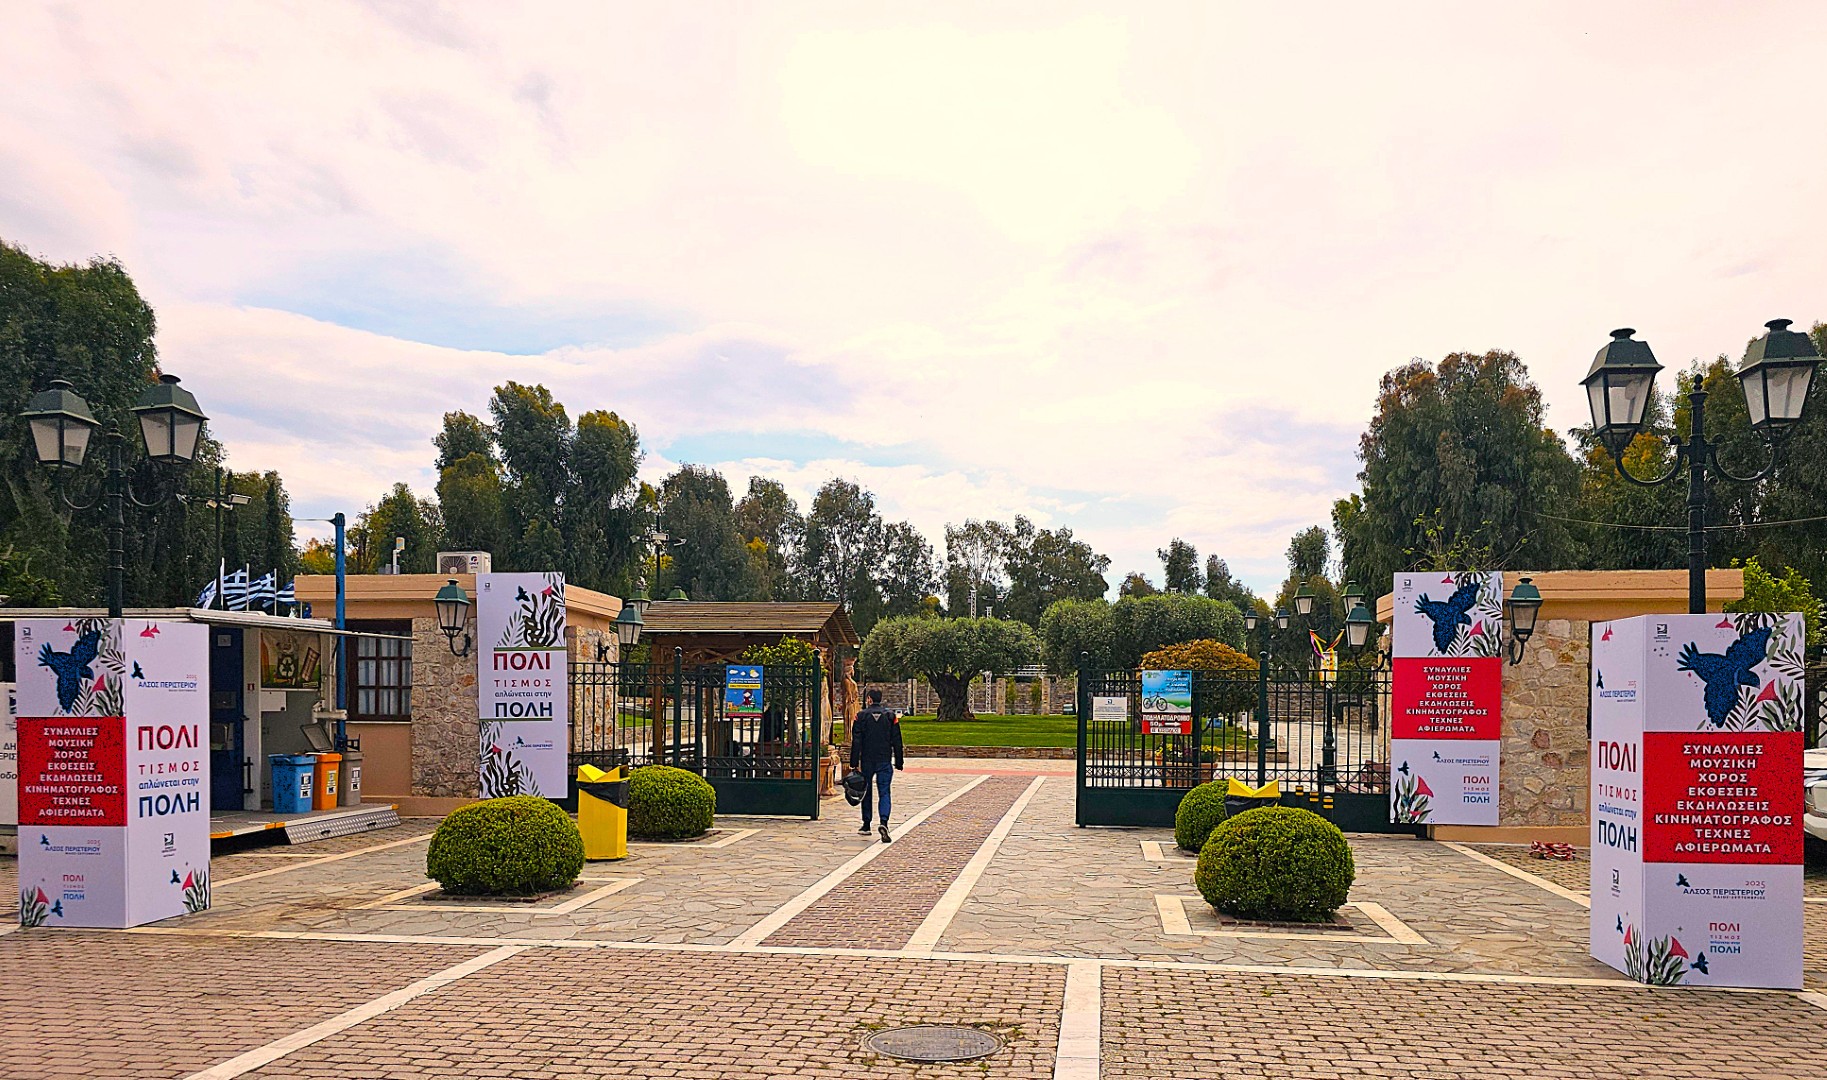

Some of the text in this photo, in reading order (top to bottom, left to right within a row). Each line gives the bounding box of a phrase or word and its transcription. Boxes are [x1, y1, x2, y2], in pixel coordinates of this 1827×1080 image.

[494, 652, 550, 670] ΠΟΛΙ
[494, 679, 551, 688] ΤΙΣΜΟΣ
[495, 702, 552, 718] ΠΟΛΗ
[44, 727, 98, 736] ΣΥΝΑΥΛΙΕΣ
[138, 724, 198, 751] ΠΟΛΙ
[48, 739, 94, 747] ΜΟΥΣΙΚΗ
[1683, 744, 1764, 754] ΣΥΝΑΥΛΙΕΣ
[54, 751, 88, 759] ΧΟΡΟΣ
[1598, 741, 1636, 772] ΠΟΛΙ
[48, 762, 96, 770] ΕΚΘΕΣΕΙΣ
[138, 760, 200, 776] ΤΙΣΜΟΣ
[1690, 759, 1756, 768] ΜΟΥΣΙΚΗ
[40, 774, 103, 782] ΕΚΔΗΛΩΣΕΙΣ
[1464, 776, 1490, 784] ΠΟΛΙ
[1698, 774, 1748, 782] ΧΟΡΟΣ
[138, 777, 200, 790] απλώνεται στην
[25, 786, 118, 794] ΚΙΝΗΜΑΤΟΓΡΑΦΟΣ
[1598, 784, 1637, 802] ΤΙΣΜΟΣ
[1688, 787, 1758, 796] ΕΚΘΕΣΕΙΣ
[52, 797, 91, 806] ΤΕΧΝΕΣ
[138, 791, 200, 818] ΠΟΛΗ
[1464, 796, 1490, 804] ΠΟΛΗ
[1677, 800, 1770, 811] ΕΚΔΗΛΩΣΕΙΣ
[38, 808, 104, 817] ΑΦΙΕΡΩΜΑΤΑ
[1655, 814, 1792, 825] ΚΙΝΗΜΑΤΟΓΡΑΦΟΣ
[1598, 820, 1637, 852] ΠΟΛΗ
[1695, 829, 1751, 839] ΤΕΧΝΕΣ
[1675, 842, 1771, 853] ΑΦΙΕΡΩΜΑΤΑ
[1745, 880, 1766, 888] 2025
[1710, 922, 1740, 932] ΠΟΛΙ
[1710, 945, 1740, 954] ΠΟΛΗ
